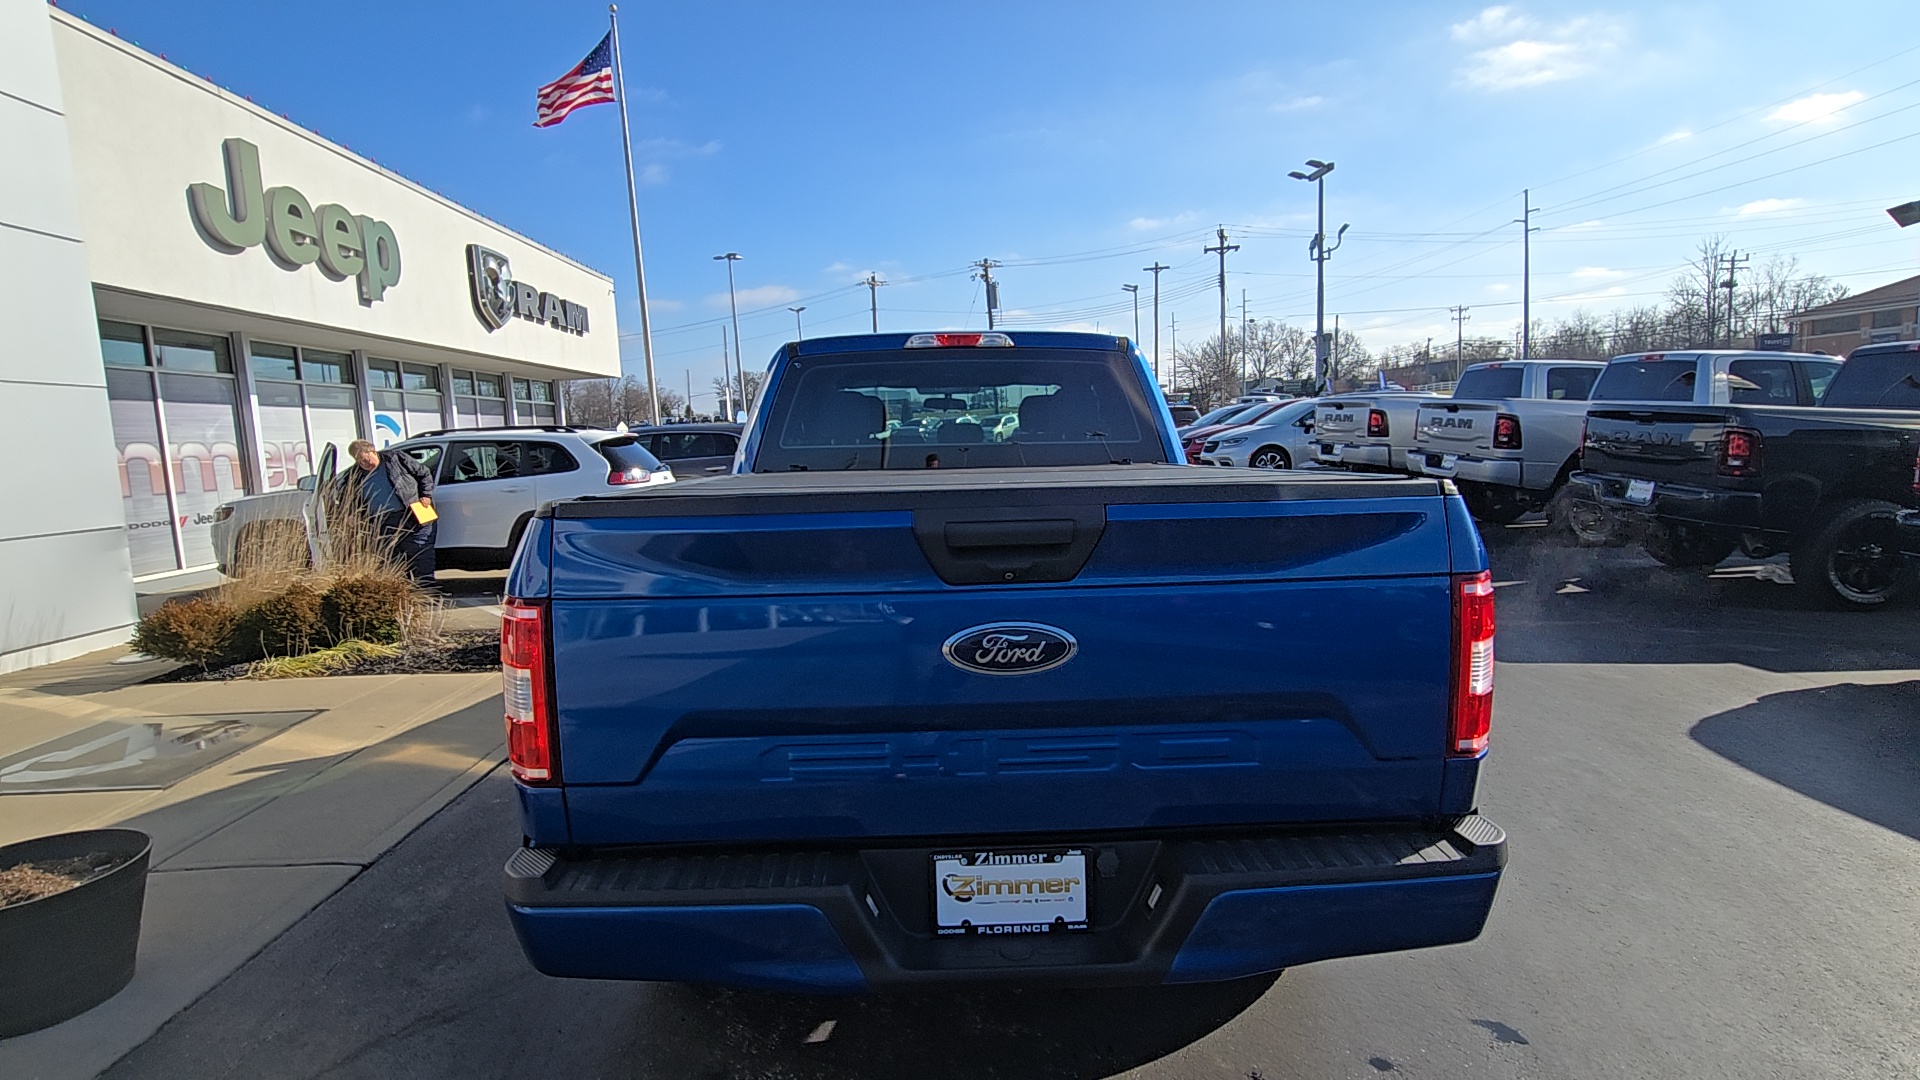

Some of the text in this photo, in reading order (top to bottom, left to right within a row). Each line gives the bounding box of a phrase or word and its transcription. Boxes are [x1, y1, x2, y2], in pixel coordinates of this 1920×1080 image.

[186, 138, 401, 307] Jeep
[512, 281, 591, 336] RAM
[1324, 413, 1354, 423] RAM
[1431, 416, 1474, 429] RAM
[1611, 429, 1682, 447] RAM
[128, 512, 214, 530] DODG Jee
[975, 634, 1046, 664] Ford
[974, 851, 1048, 865] Zimmer
[951, 875, 1080, 897] Zimmer
[977, 924, 1049, 934] FLORENCE
